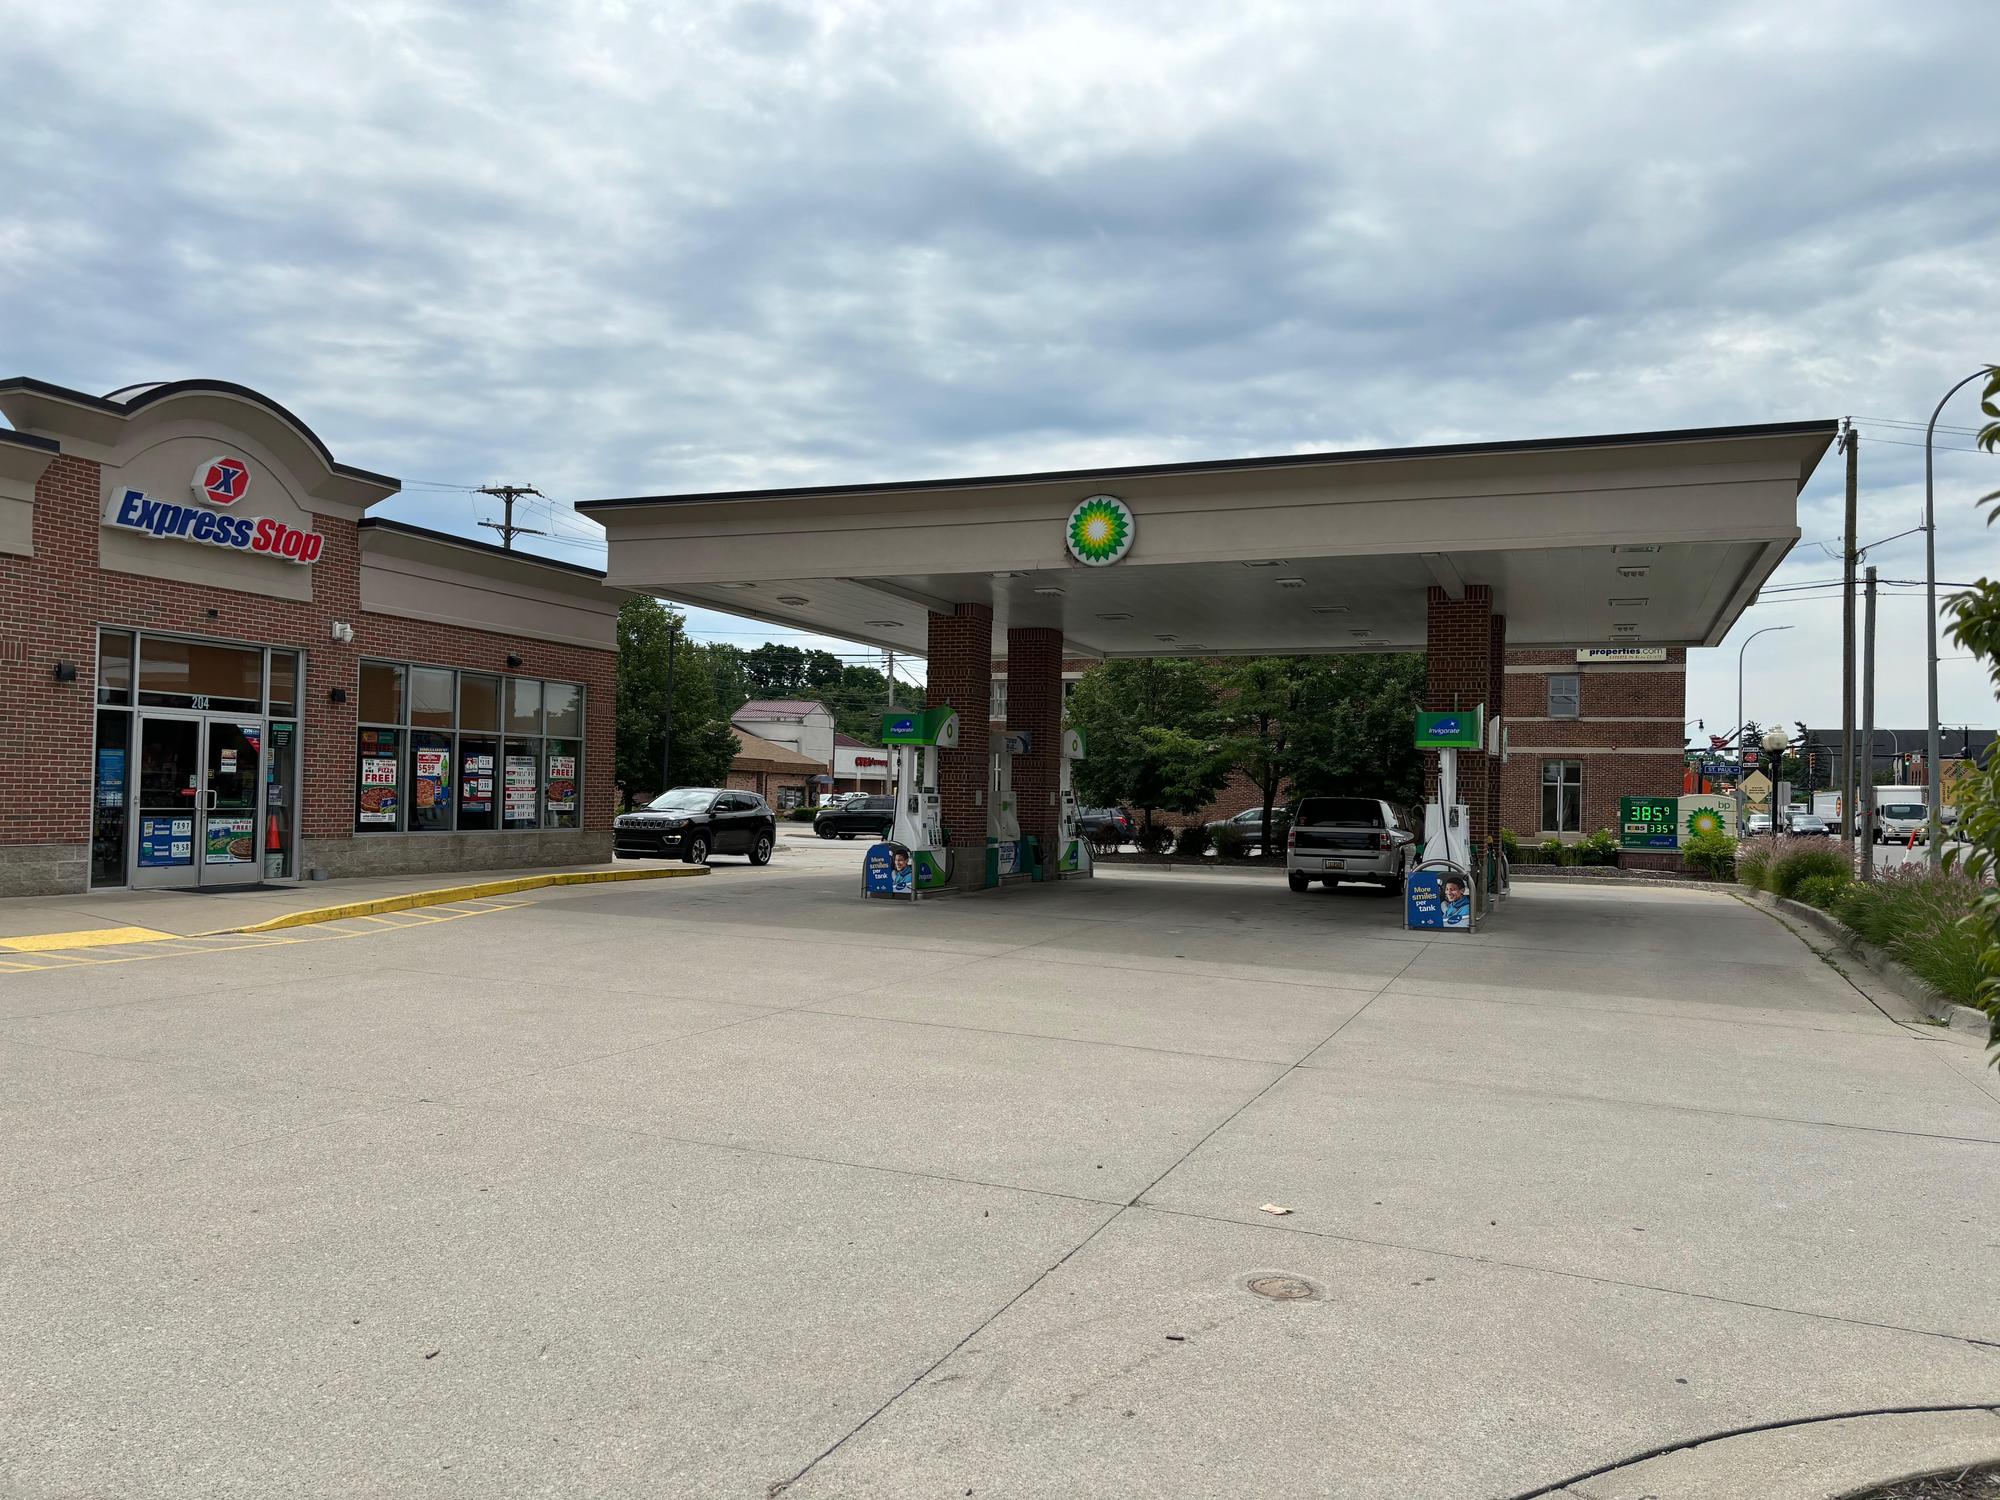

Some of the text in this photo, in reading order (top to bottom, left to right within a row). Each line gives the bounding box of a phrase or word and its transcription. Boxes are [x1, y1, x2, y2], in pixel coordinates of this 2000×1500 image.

[210, 467, 241, 494] X
[116, 490, 323, 562] Express Stop
[191, 695, 210, 710] 204
[1428, 727, 1460, 736] Invigorate
[551, 768, 573, 777] FREE!
[364, 773, 394, 783] FREE!
[1718, 801, 1731, 810] bp
[1412, 892, 1437, 900] smiles
[1419, 904, 1436, 912] tank
